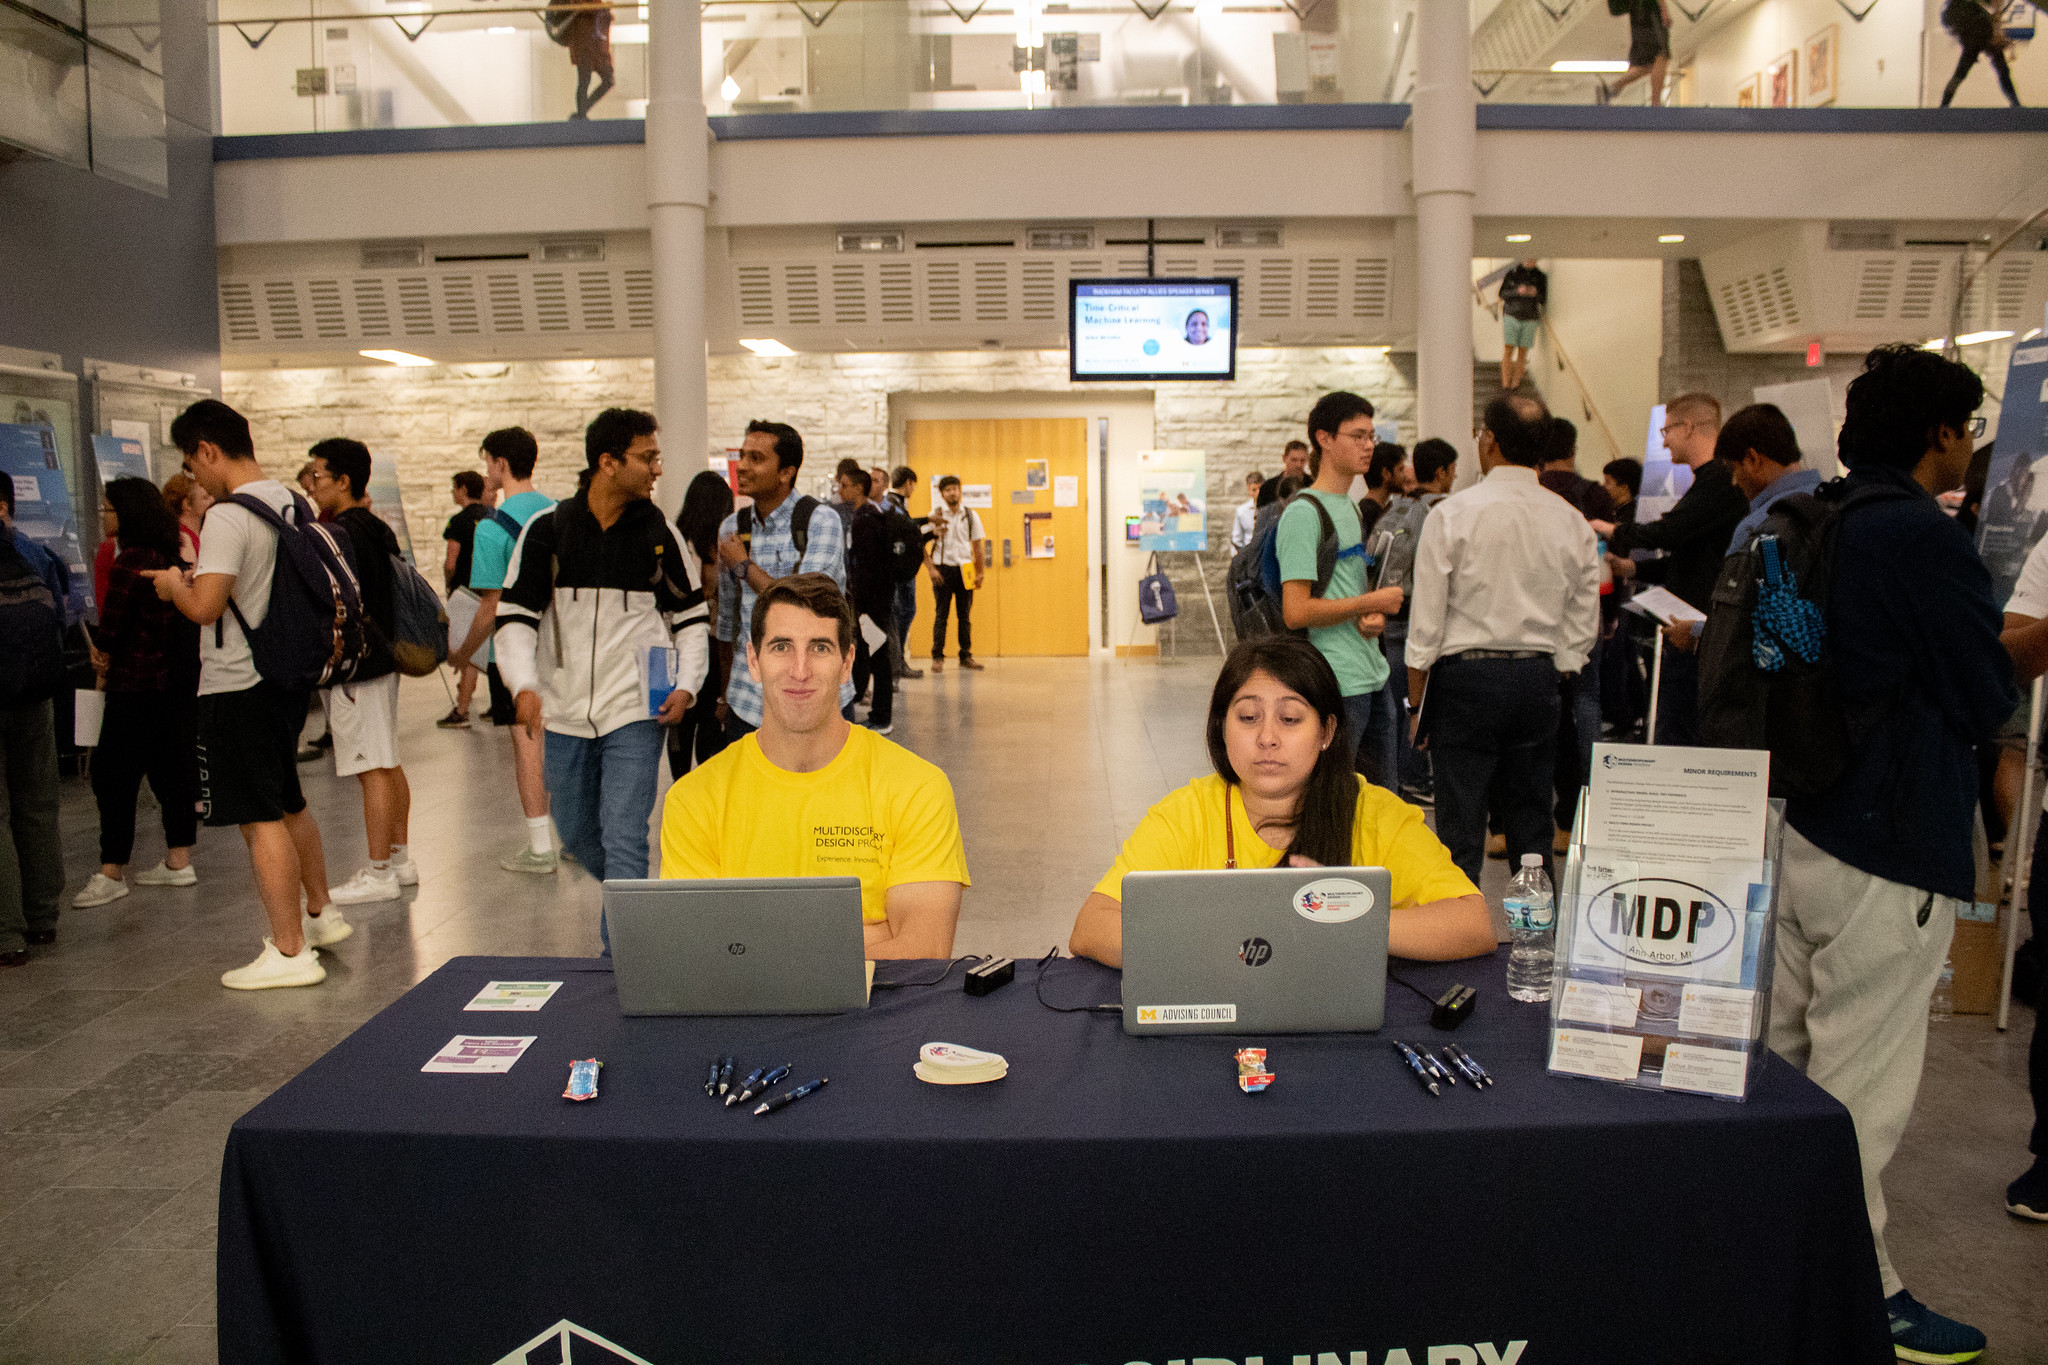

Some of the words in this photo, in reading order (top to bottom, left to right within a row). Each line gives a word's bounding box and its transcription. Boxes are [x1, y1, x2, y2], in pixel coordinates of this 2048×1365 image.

[1085, 316, 1121, 324] Machine
[1124, 316, 1161, 325] Learning
[1708, 769, 1758, 778] REQUIREMENTS
[815, 838, 855, 847] DESIGN
[1609, 892, 1716, 944] MDP
[728, 942, 746, 957] hp
[1241, 937, 1272, 967] hp
[1629, 945, 1647, 958] Ann
[1650, 950, 1677, 961] Arbor,
[1162, 1009, 1198, 1021] ADVISING
[1200, 1008, 1232, 1020] COUNCIL
